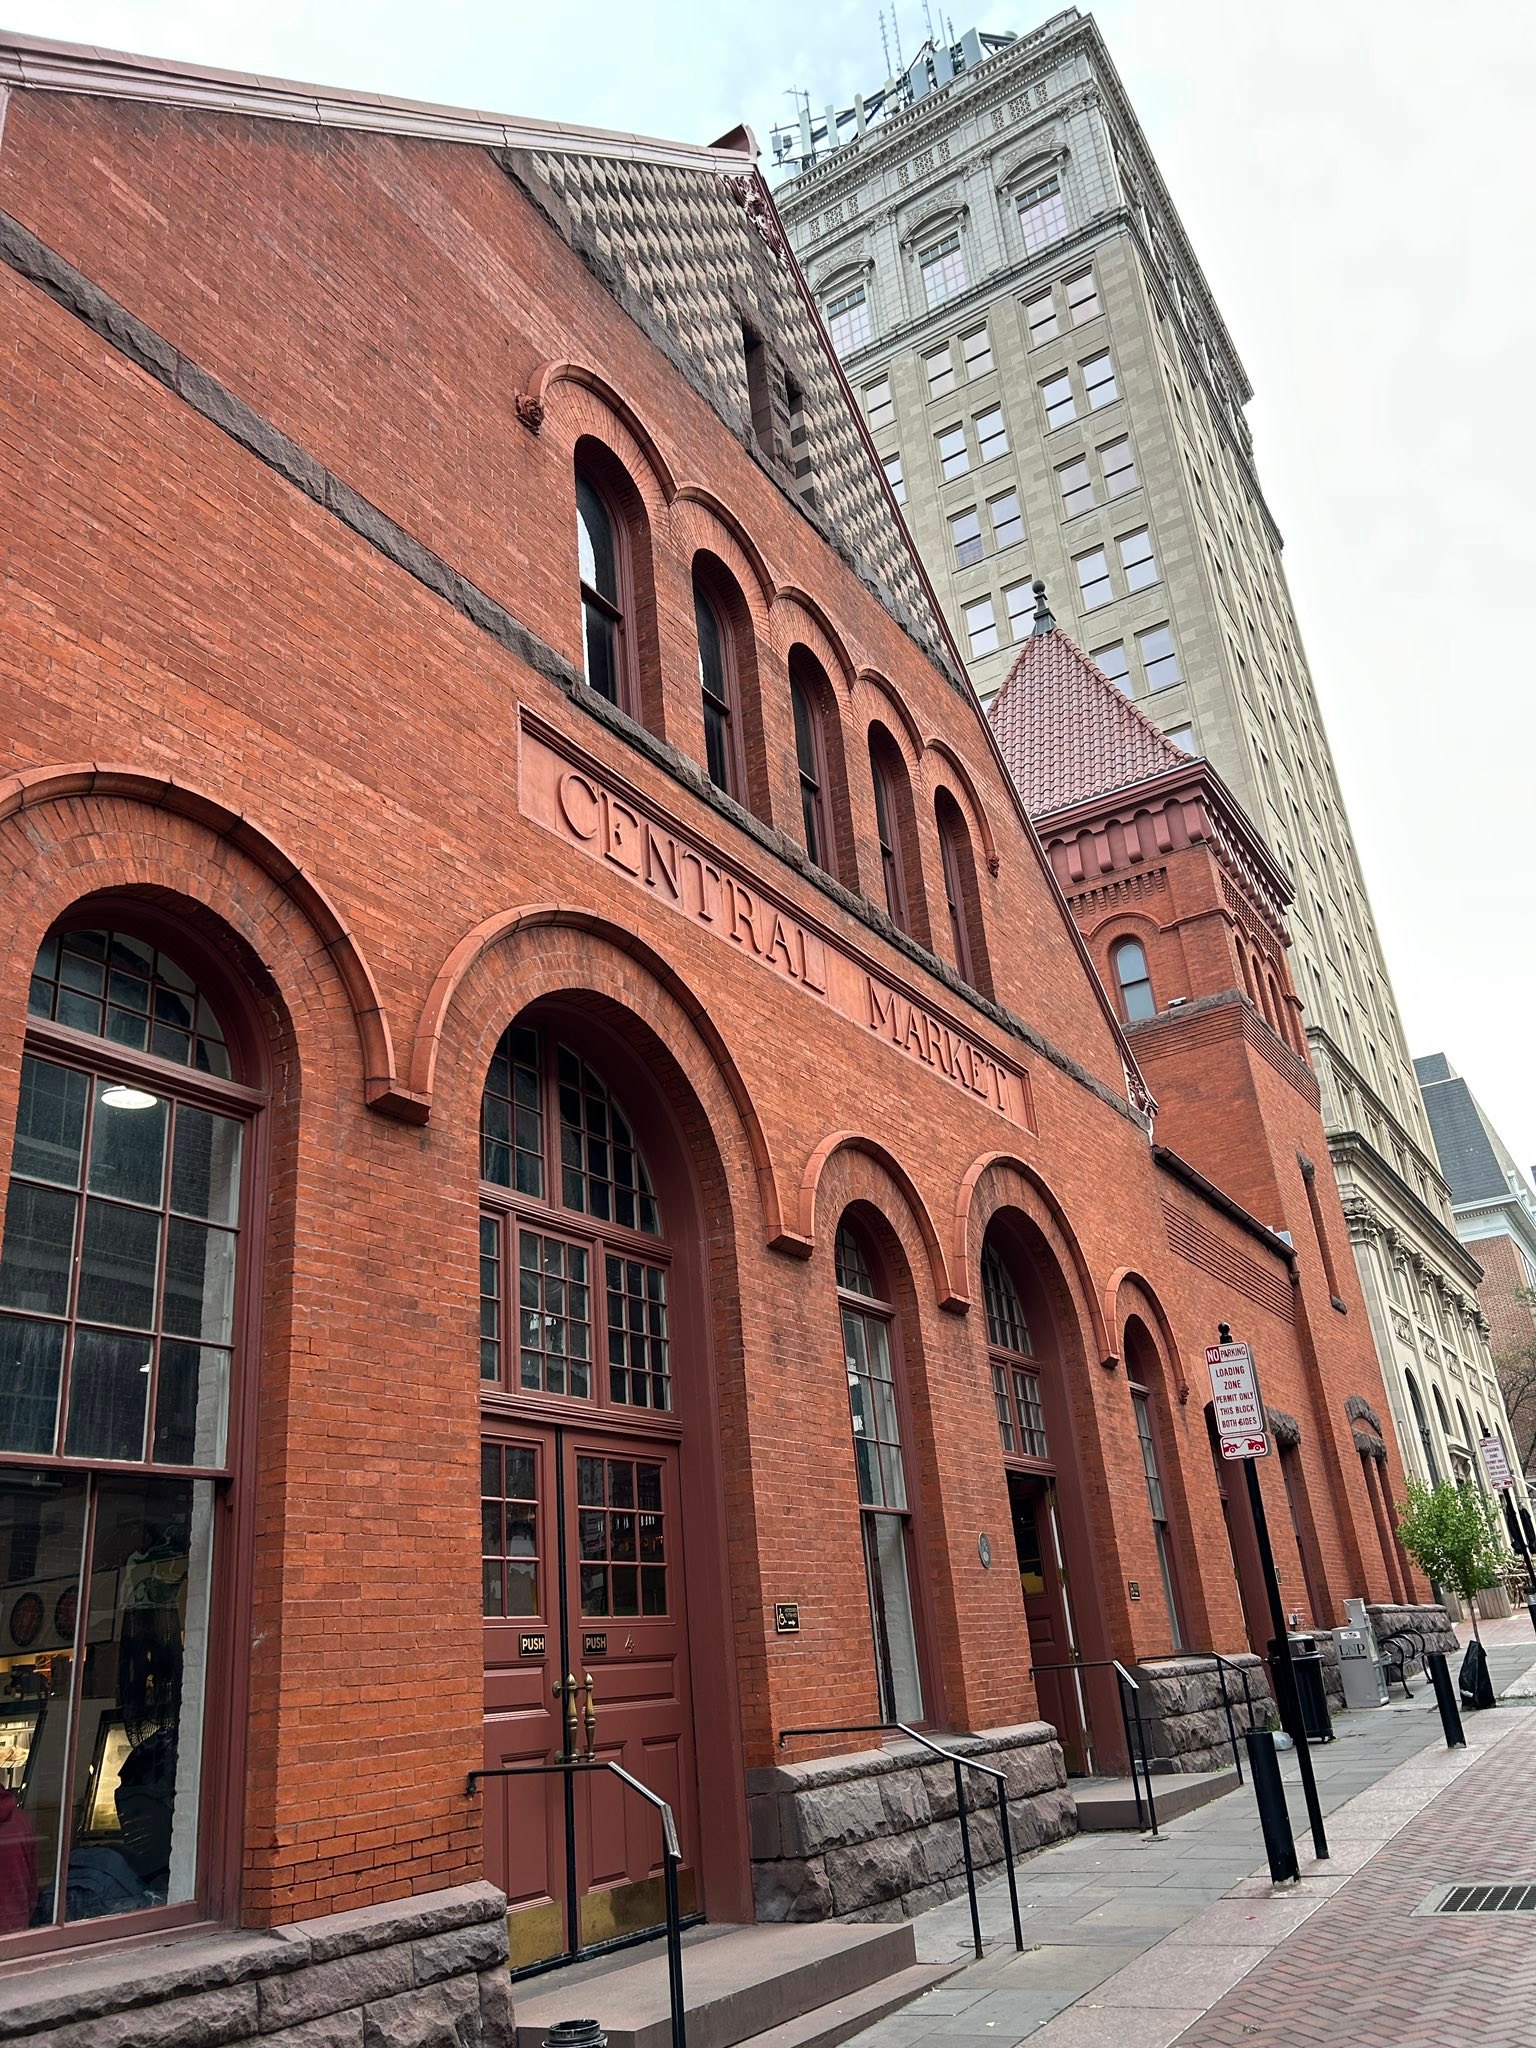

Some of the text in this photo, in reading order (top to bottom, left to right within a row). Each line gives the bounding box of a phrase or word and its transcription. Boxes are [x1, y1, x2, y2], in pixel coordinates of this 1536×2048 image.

[559, 771, 1010, 1111] CENTRAL MARKET
[1207, 1347, 1246, 1362] NO PARKING
[1216, 1366, 1245, 1378] LOADING
[1224, 1380, 1241, 1390] ZONE
[1216, 1391, 1254, 1404] PERMIT ONLY
[1220, 1404, 1255, 1416] THIS BLOCK
[1222, 1419, 1238, 1428] BOTH
[522, 1637, 545, 1650] PUSH
[585, 1637, 606, 1649] PUSH
[1339, 1644, 1365, 1656] LNP
